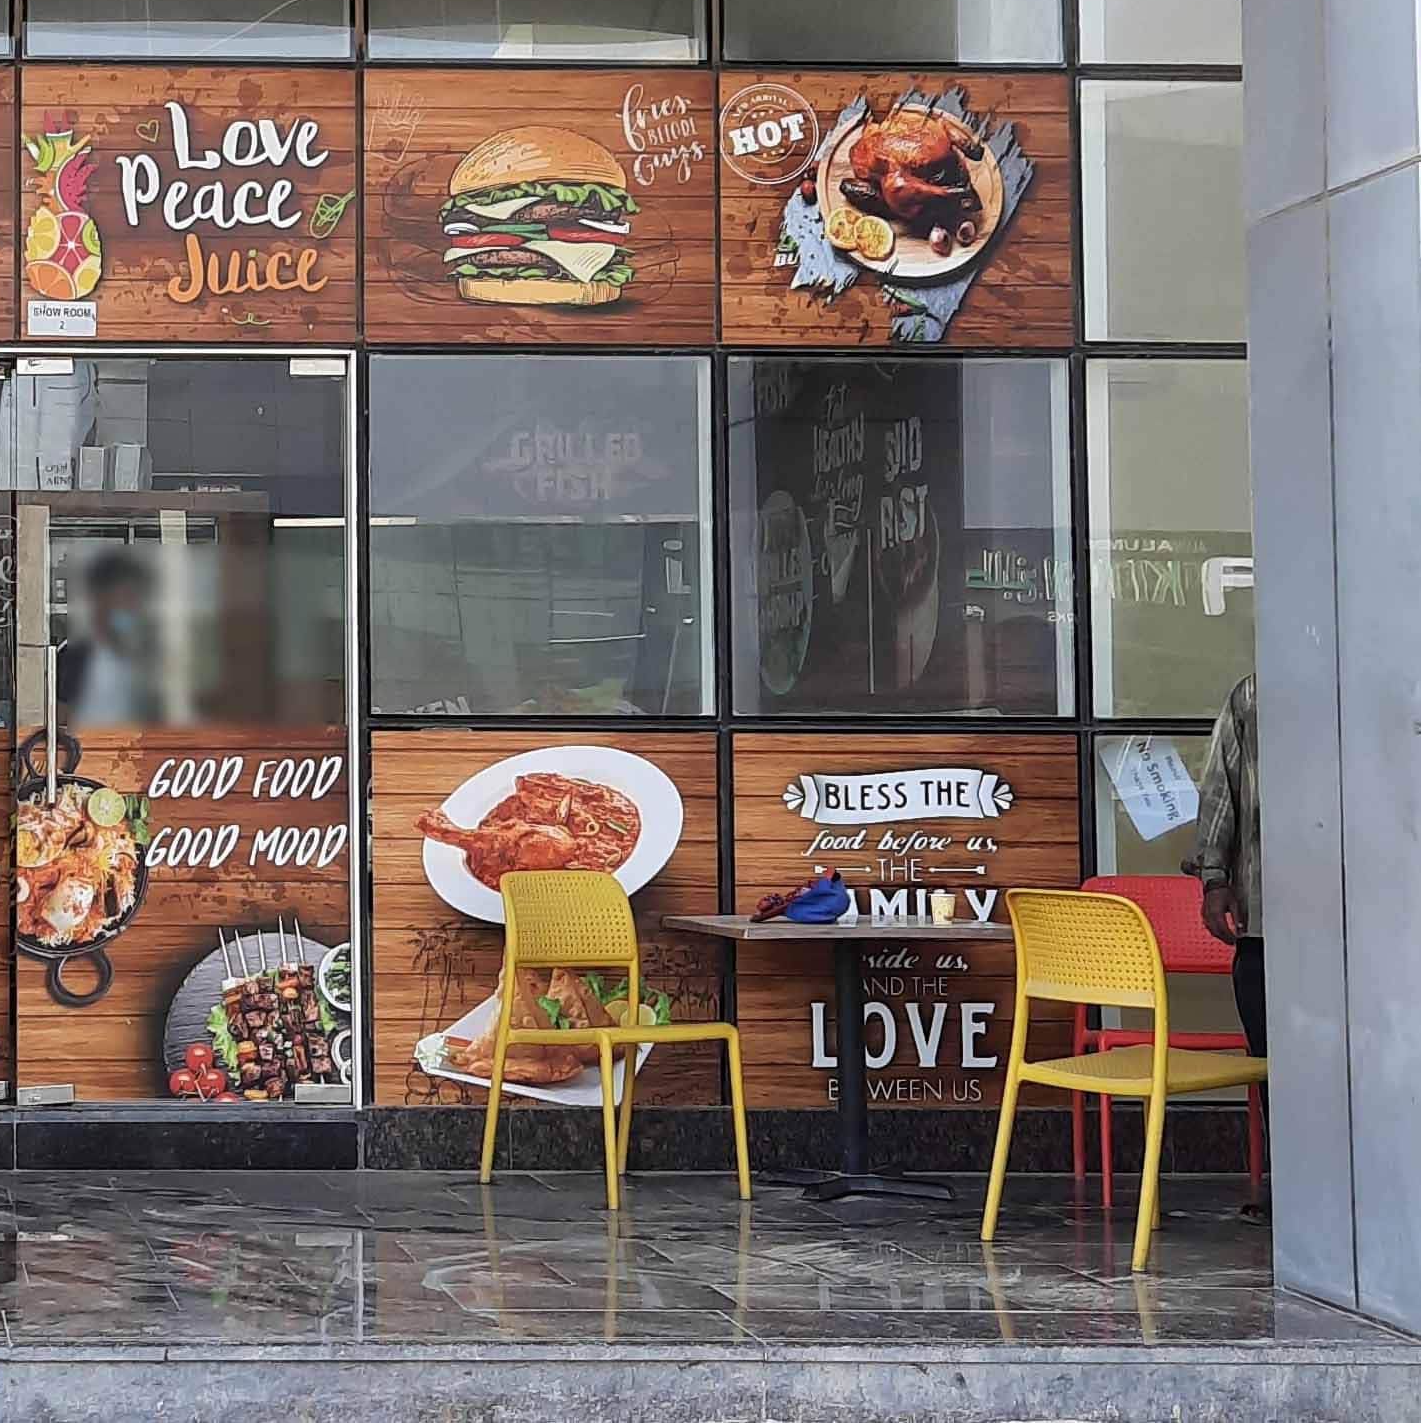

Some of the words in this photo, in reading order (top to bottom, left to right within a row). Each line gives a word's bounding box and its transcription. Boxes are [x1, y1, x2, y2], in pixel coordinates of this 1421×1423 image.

[728, 113, 805, 156] HOT
[116, 153, 302, 230] Peace
[167, 232, 329, 304] Juice
[64, 308, 91, 318] ROOM
[148, 757, 243, 801] GOOD
[252, 755, 343, 801] FOOD
[824, 783, 908, 811] BLESS
[919, 780, 971, 808] THE
[145, 824, 240, 869] GOOD
[249, 824, 348, 869] MOOD
[800, 829, 867, 857] food
[877, 829, 952, 857] before
[876, 857, 924, 882] THE
[914, 977, 948, 997] THE
[810, 1001, 999, 1069] LOVE
[953, 1079, 983, 1102] US
